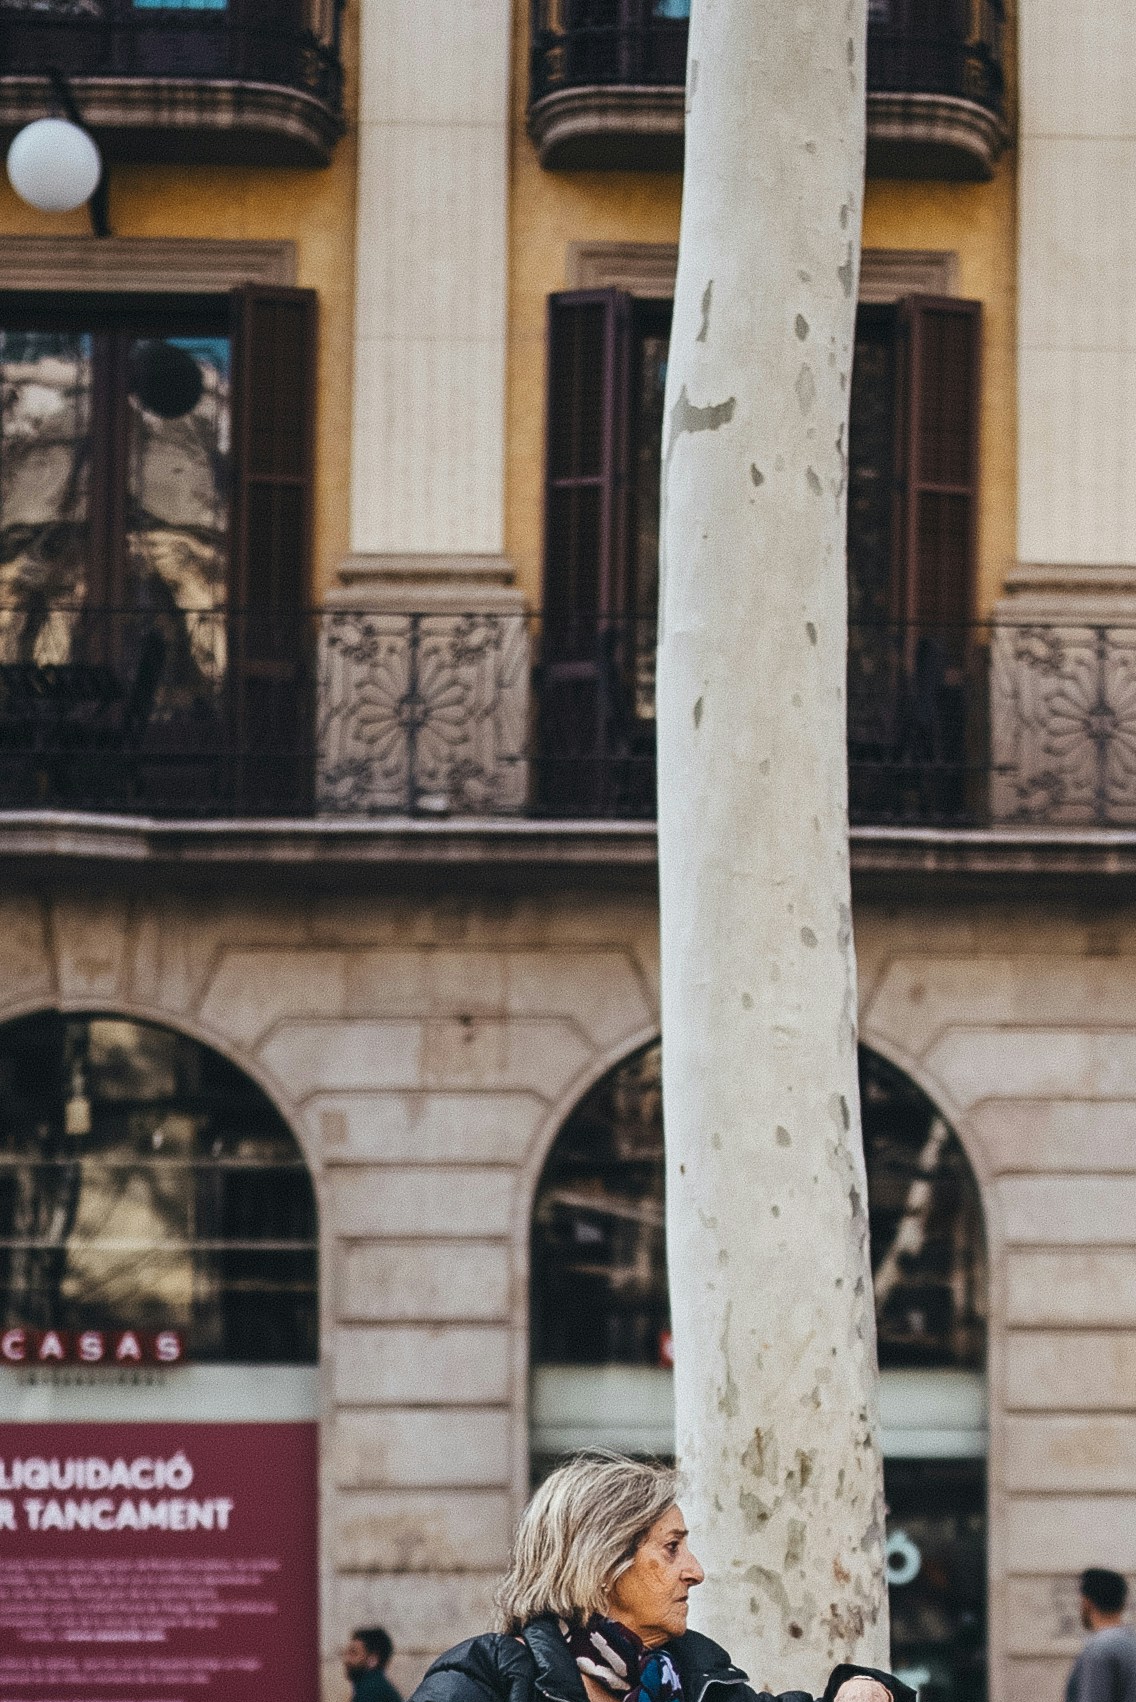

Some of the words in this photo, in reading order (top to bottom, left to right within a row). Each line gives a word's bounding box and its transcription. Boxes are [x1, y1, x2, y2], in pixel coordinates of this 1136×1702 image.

[1, 1328, 181, 1362] CASAS
[0, 1450, 194, 1490] LIQUIDACIÓ
[23, 1497, 233, 1531] TANCAMENT
